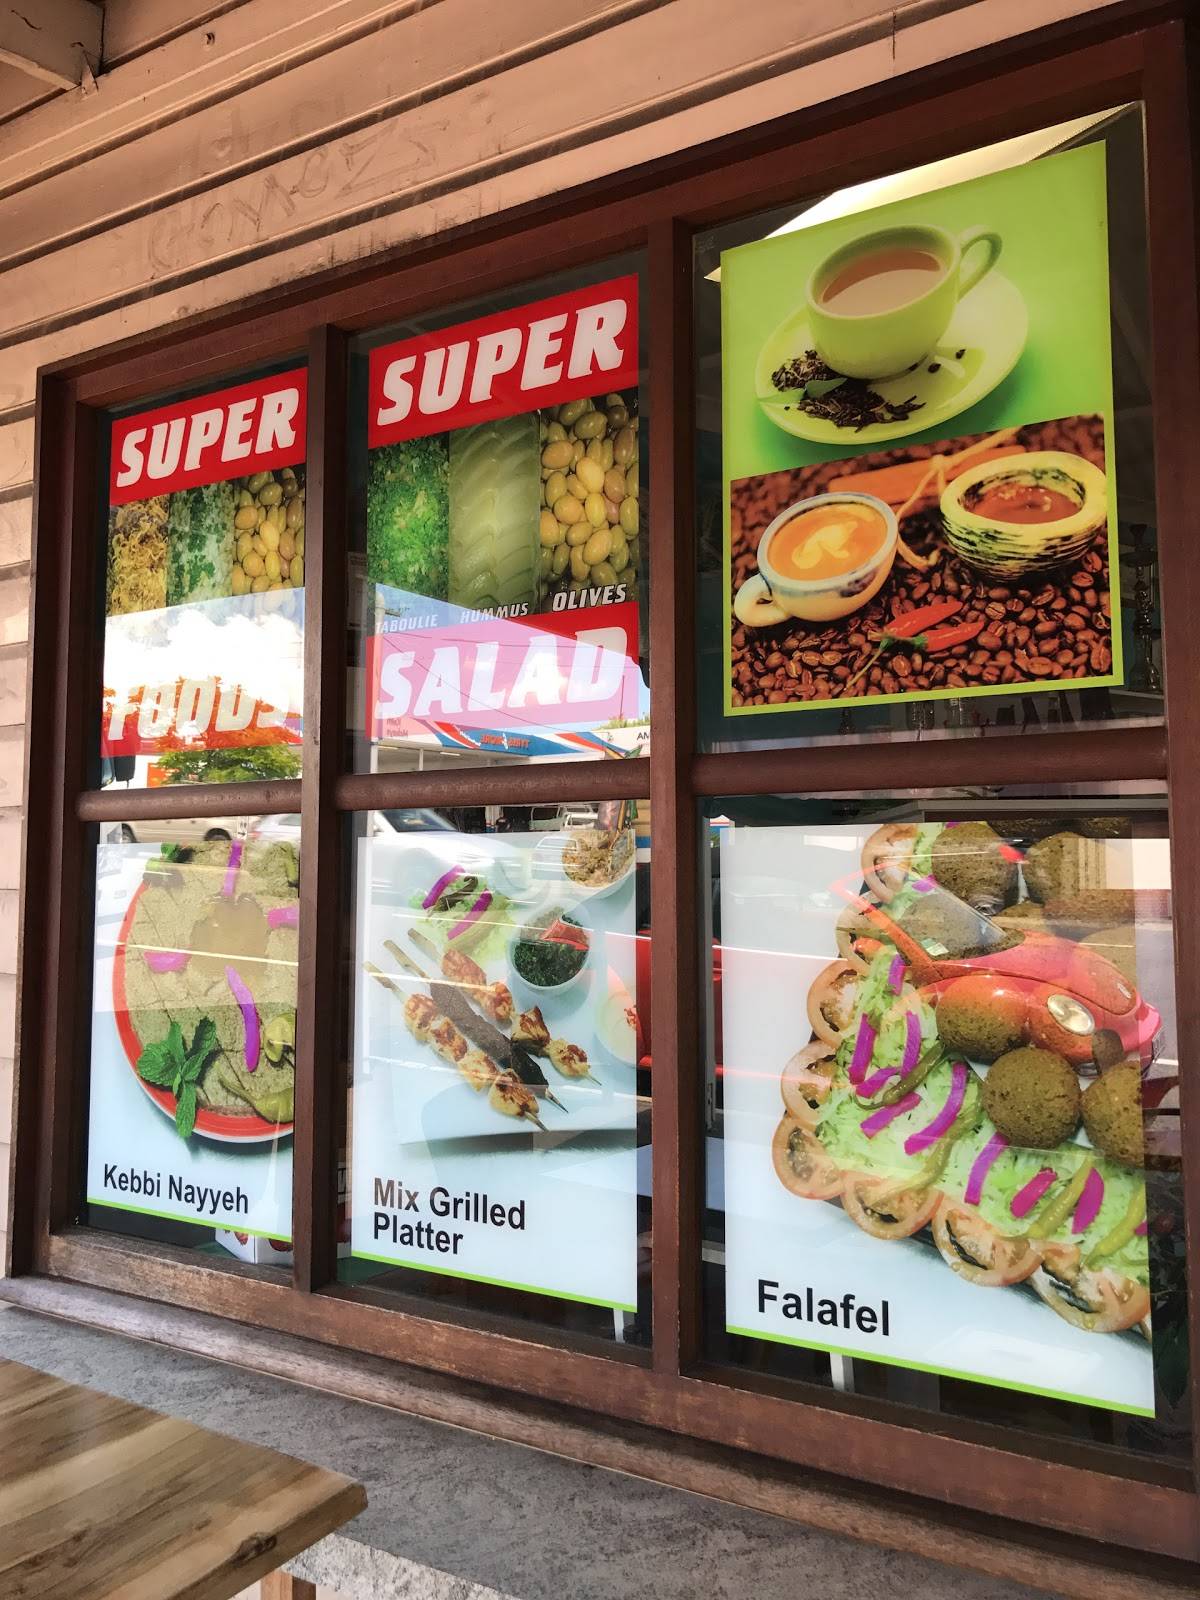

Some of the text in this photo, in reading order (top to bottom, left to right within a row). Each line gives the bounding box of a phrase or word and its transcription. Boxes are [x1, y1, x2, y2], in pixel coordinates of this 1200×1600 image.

[376, 299, 627, 427] SUPER
[116, 387, 300, 488] SUPER
[460, 602, 529, 624] HUMMUS
[552, 583, 627, 612] OLIVES
[375, 626, 628, 720] SALAD
[103, 1163, 249, 1215] Kebbi Nayyeh
[374, 1177, 526, 1231] Mix Grilled
[373, 1211, 464, 1255] Platter
[757, 1278, 890, 1337] Falafel
